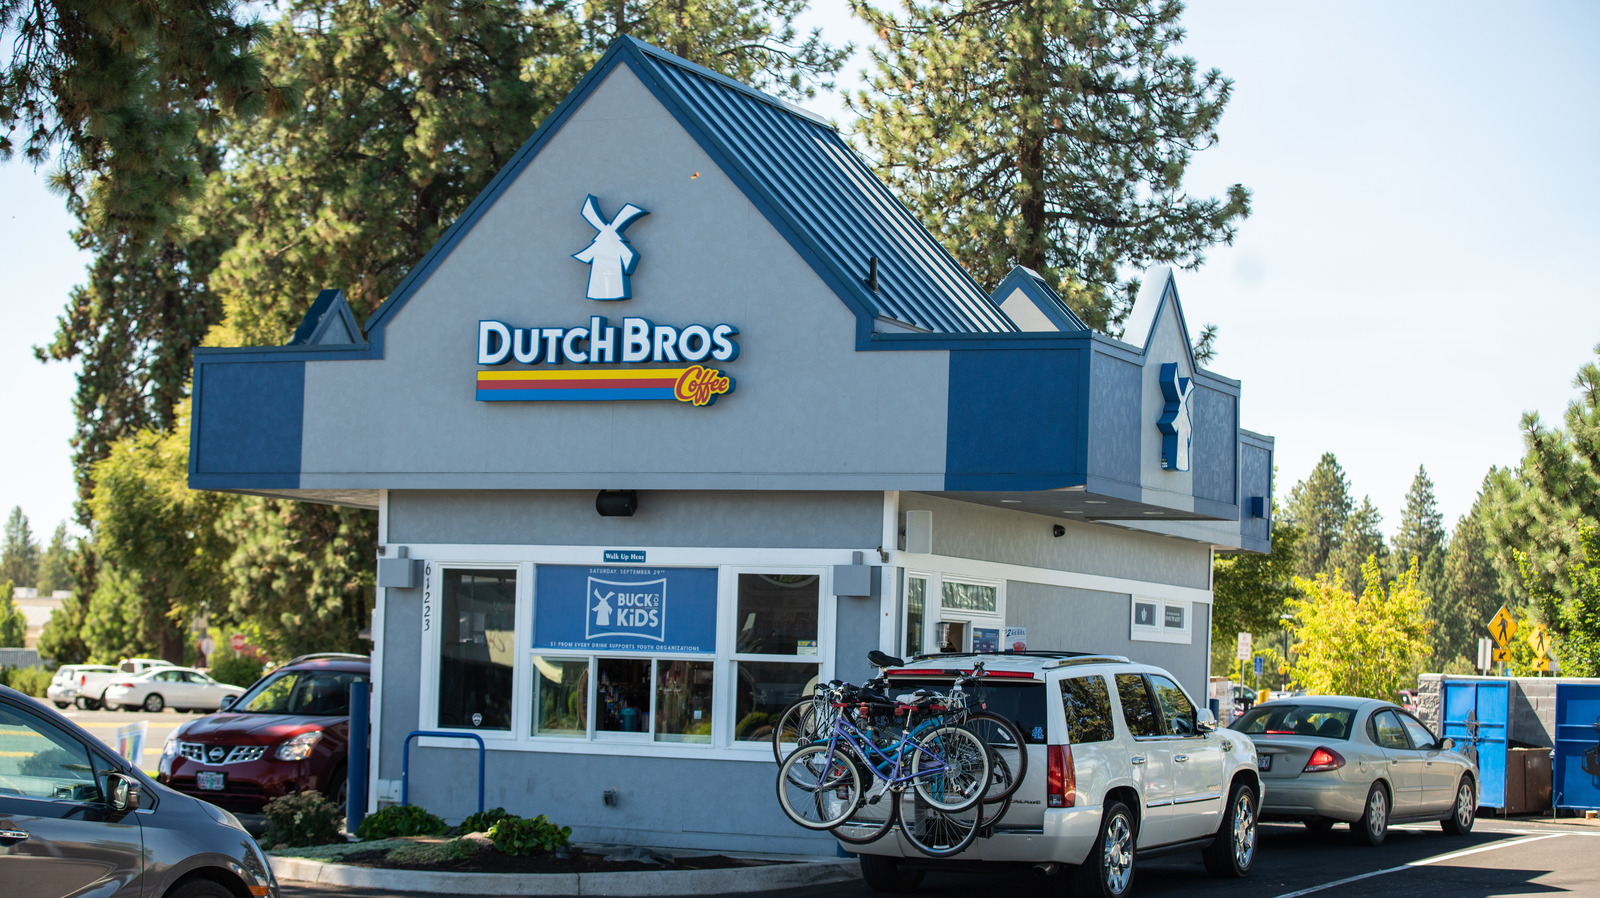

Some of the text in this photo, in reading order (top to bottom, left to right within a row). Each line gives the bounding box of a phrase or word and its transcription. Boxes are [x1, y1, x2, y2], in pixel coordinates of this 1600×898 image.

[622, 316, 738, 362] BROS
[674, 365, 729, 406] Coffee
[605, 552, 620, 560] Walk
[620, 553, 630, 561] Up
[424, 562, 432, 631] 61223
[617, 593, 653, 607] BUCK
